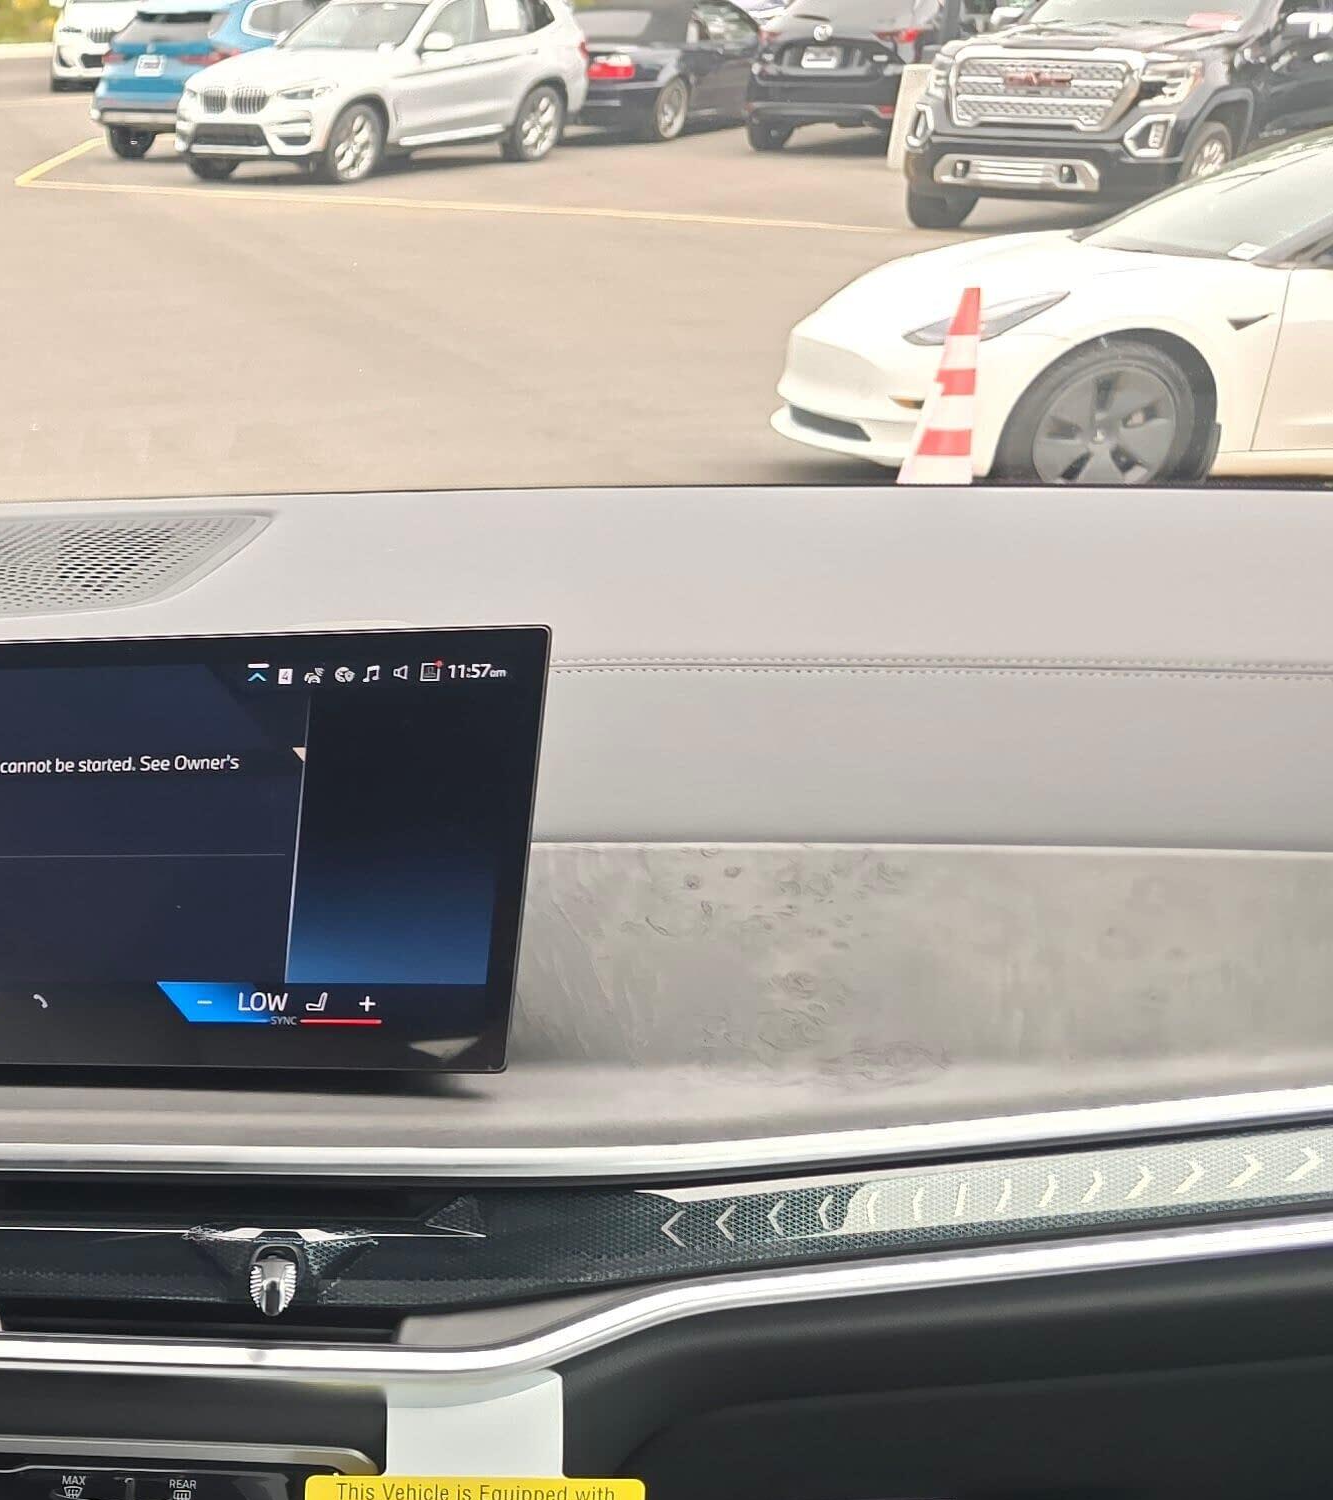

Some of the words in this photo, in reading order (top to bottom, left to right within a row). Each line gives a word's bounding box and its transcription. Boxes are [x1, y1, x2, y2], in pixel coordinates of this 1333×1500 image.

[0, 758, 52, 774] cannot
[55, 758, 74, 773] be
[78, 757, 136, 773] started.
[139, 756, 170, 772] See
[174, 754, 240, 771] Owner's
[238, 992, 288, 1012] LOW
[270, 1016, 297, 1026] SYNC
[61, 1475, 87, 1486] MAX
[169, 1479, 197, 1490] REAR
[336, 1482, 375, 1500] This
